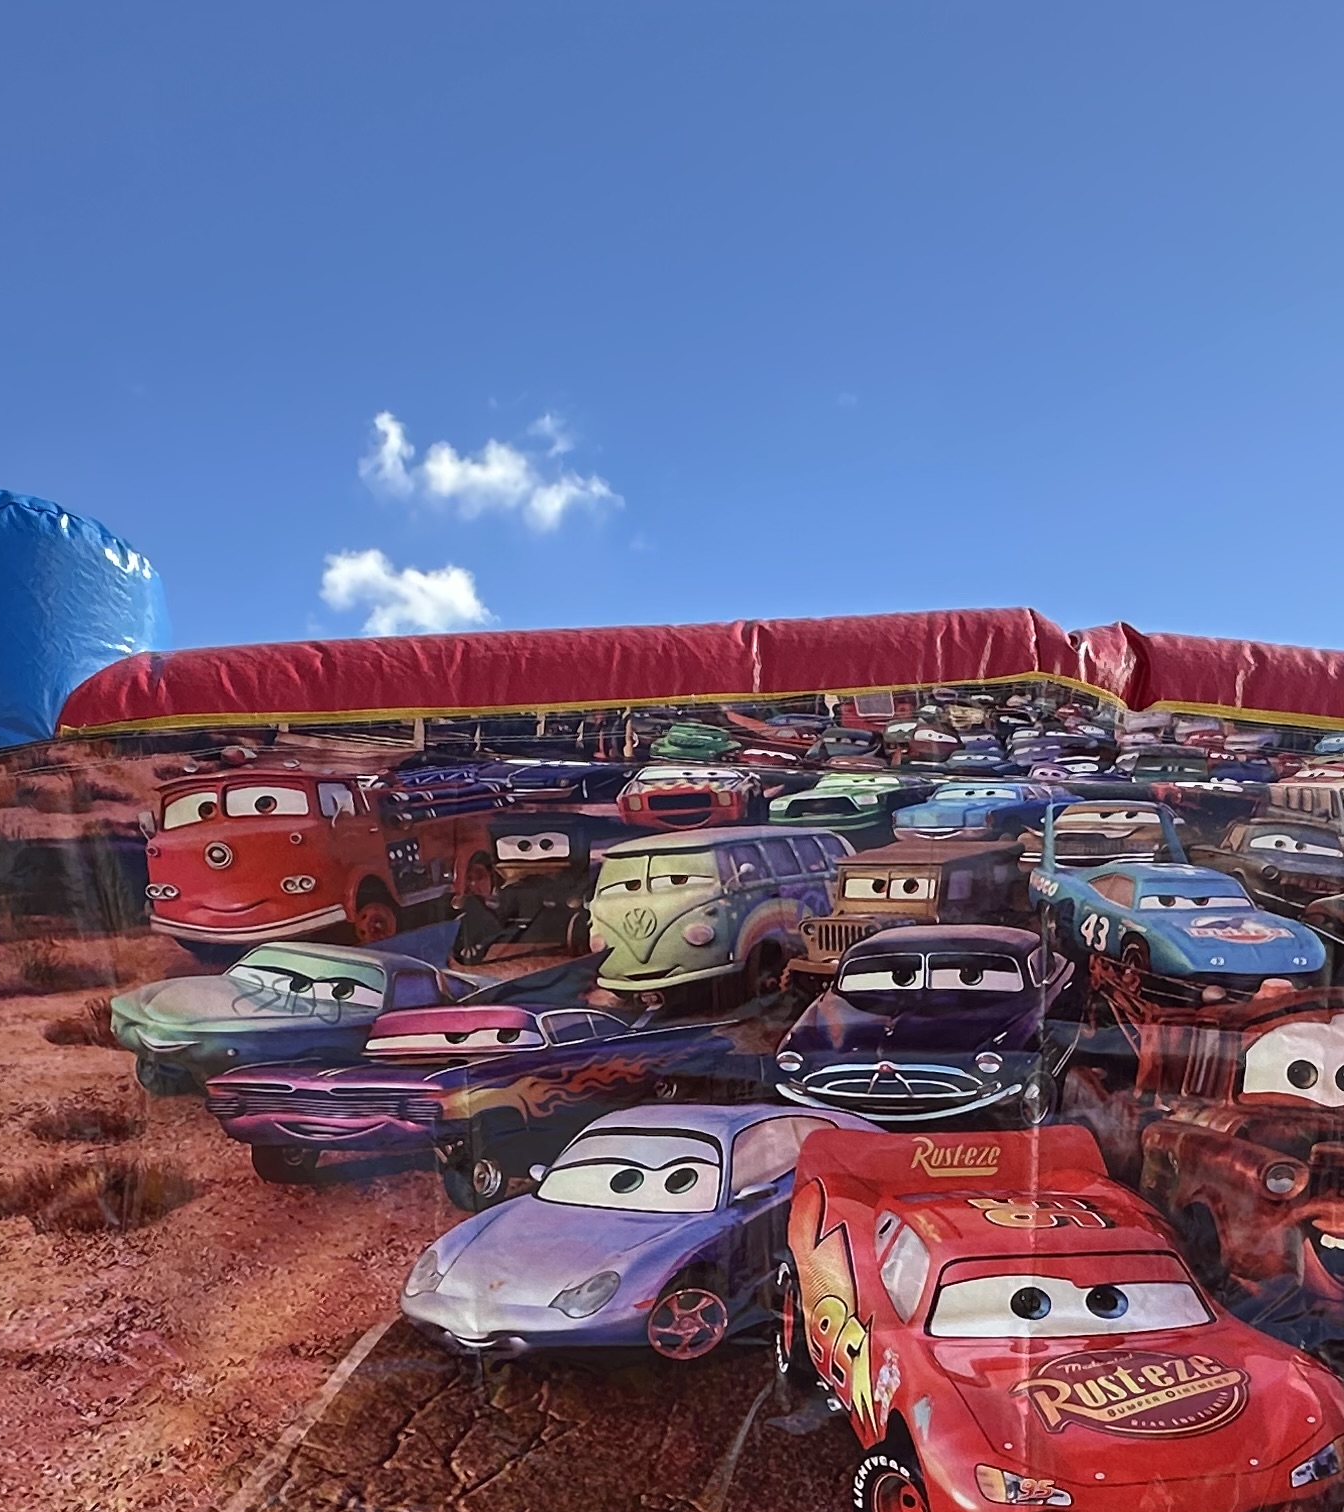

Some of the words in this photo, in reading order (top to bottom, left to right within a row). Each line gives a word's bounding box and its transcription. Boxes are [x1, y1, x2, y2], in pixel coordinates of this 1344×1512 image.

[1081, 913, 1110, 952] 43
[1210, 957, 1225, 966] 43
[1017, 1477, 1056, 1502] 95
